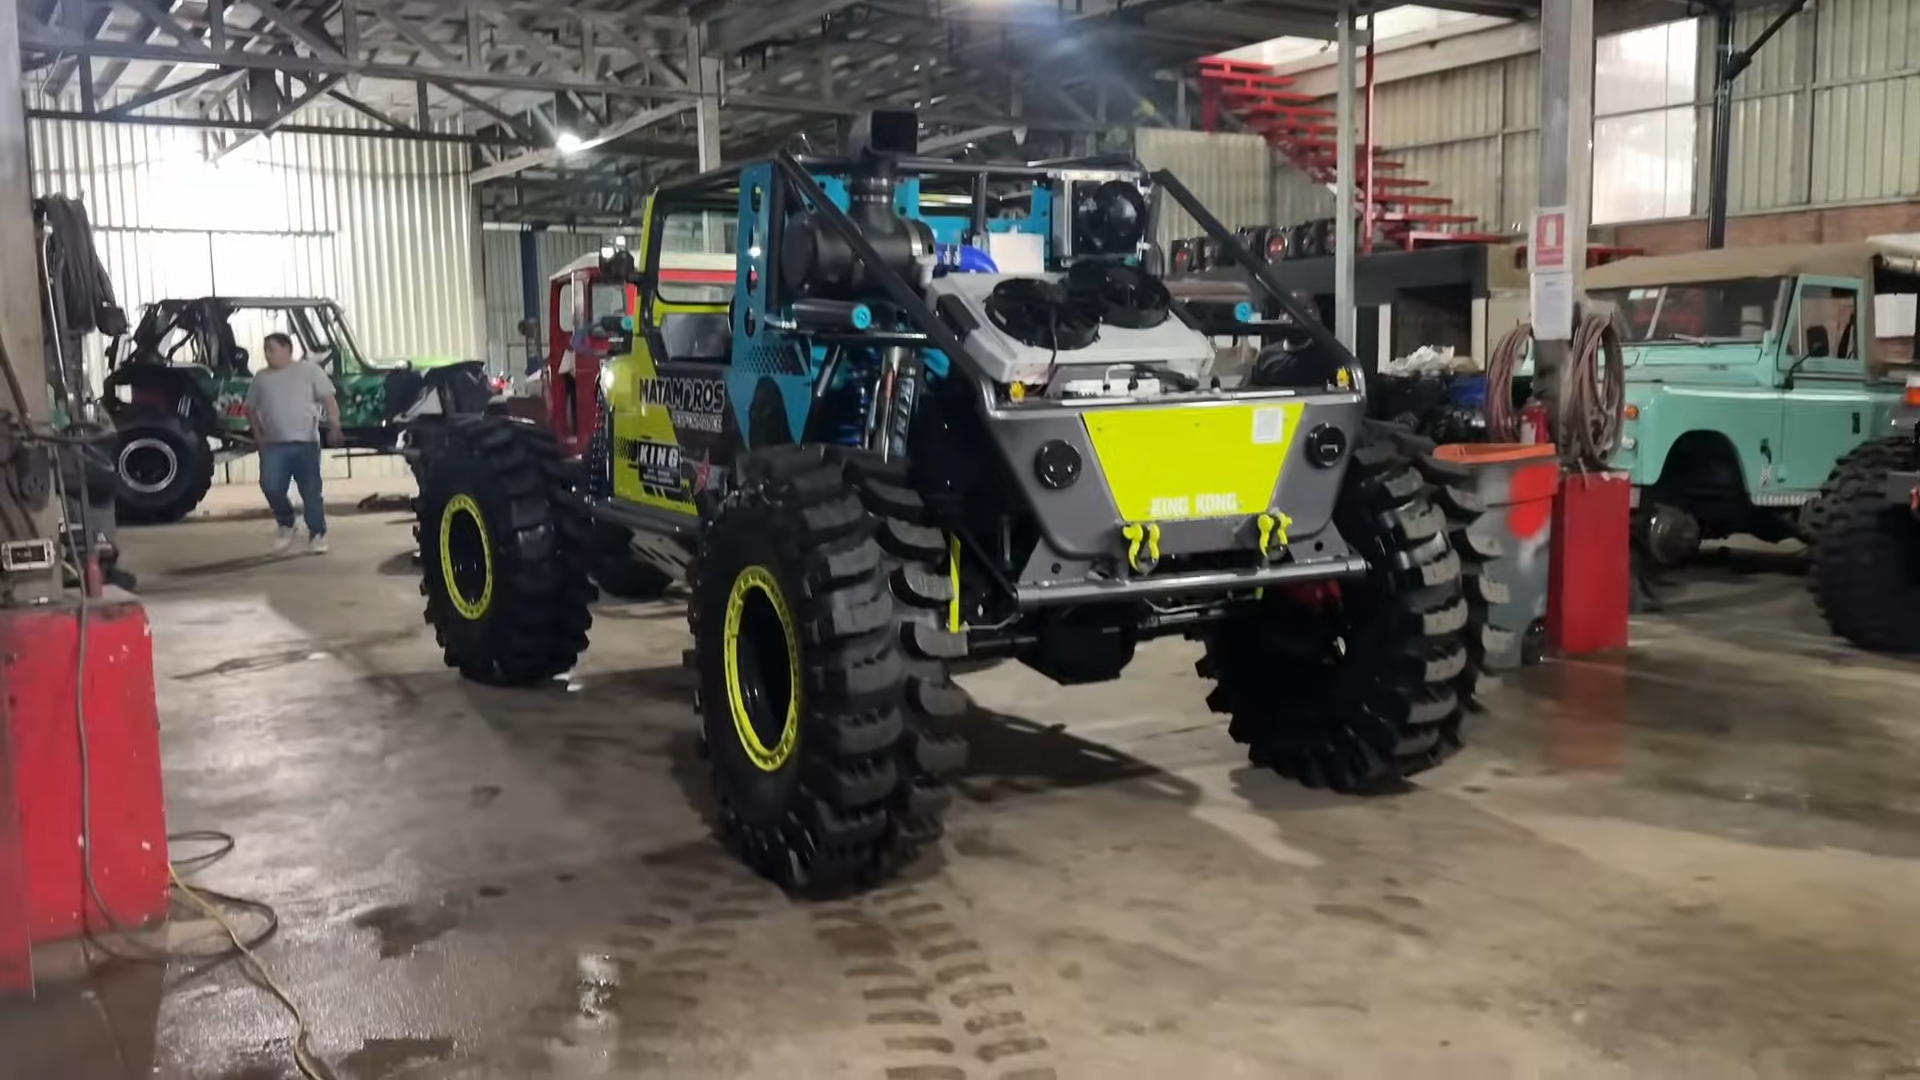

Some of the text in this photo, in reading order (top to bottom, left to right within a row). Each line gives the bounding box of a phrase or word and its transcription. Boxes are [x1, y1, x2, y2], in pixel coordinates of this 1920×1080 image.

[640, 378, 724, 411] MATAMOROS
[639, 444, 679, 468] KING
[1150, 492, 1239, 516] KING KONG
